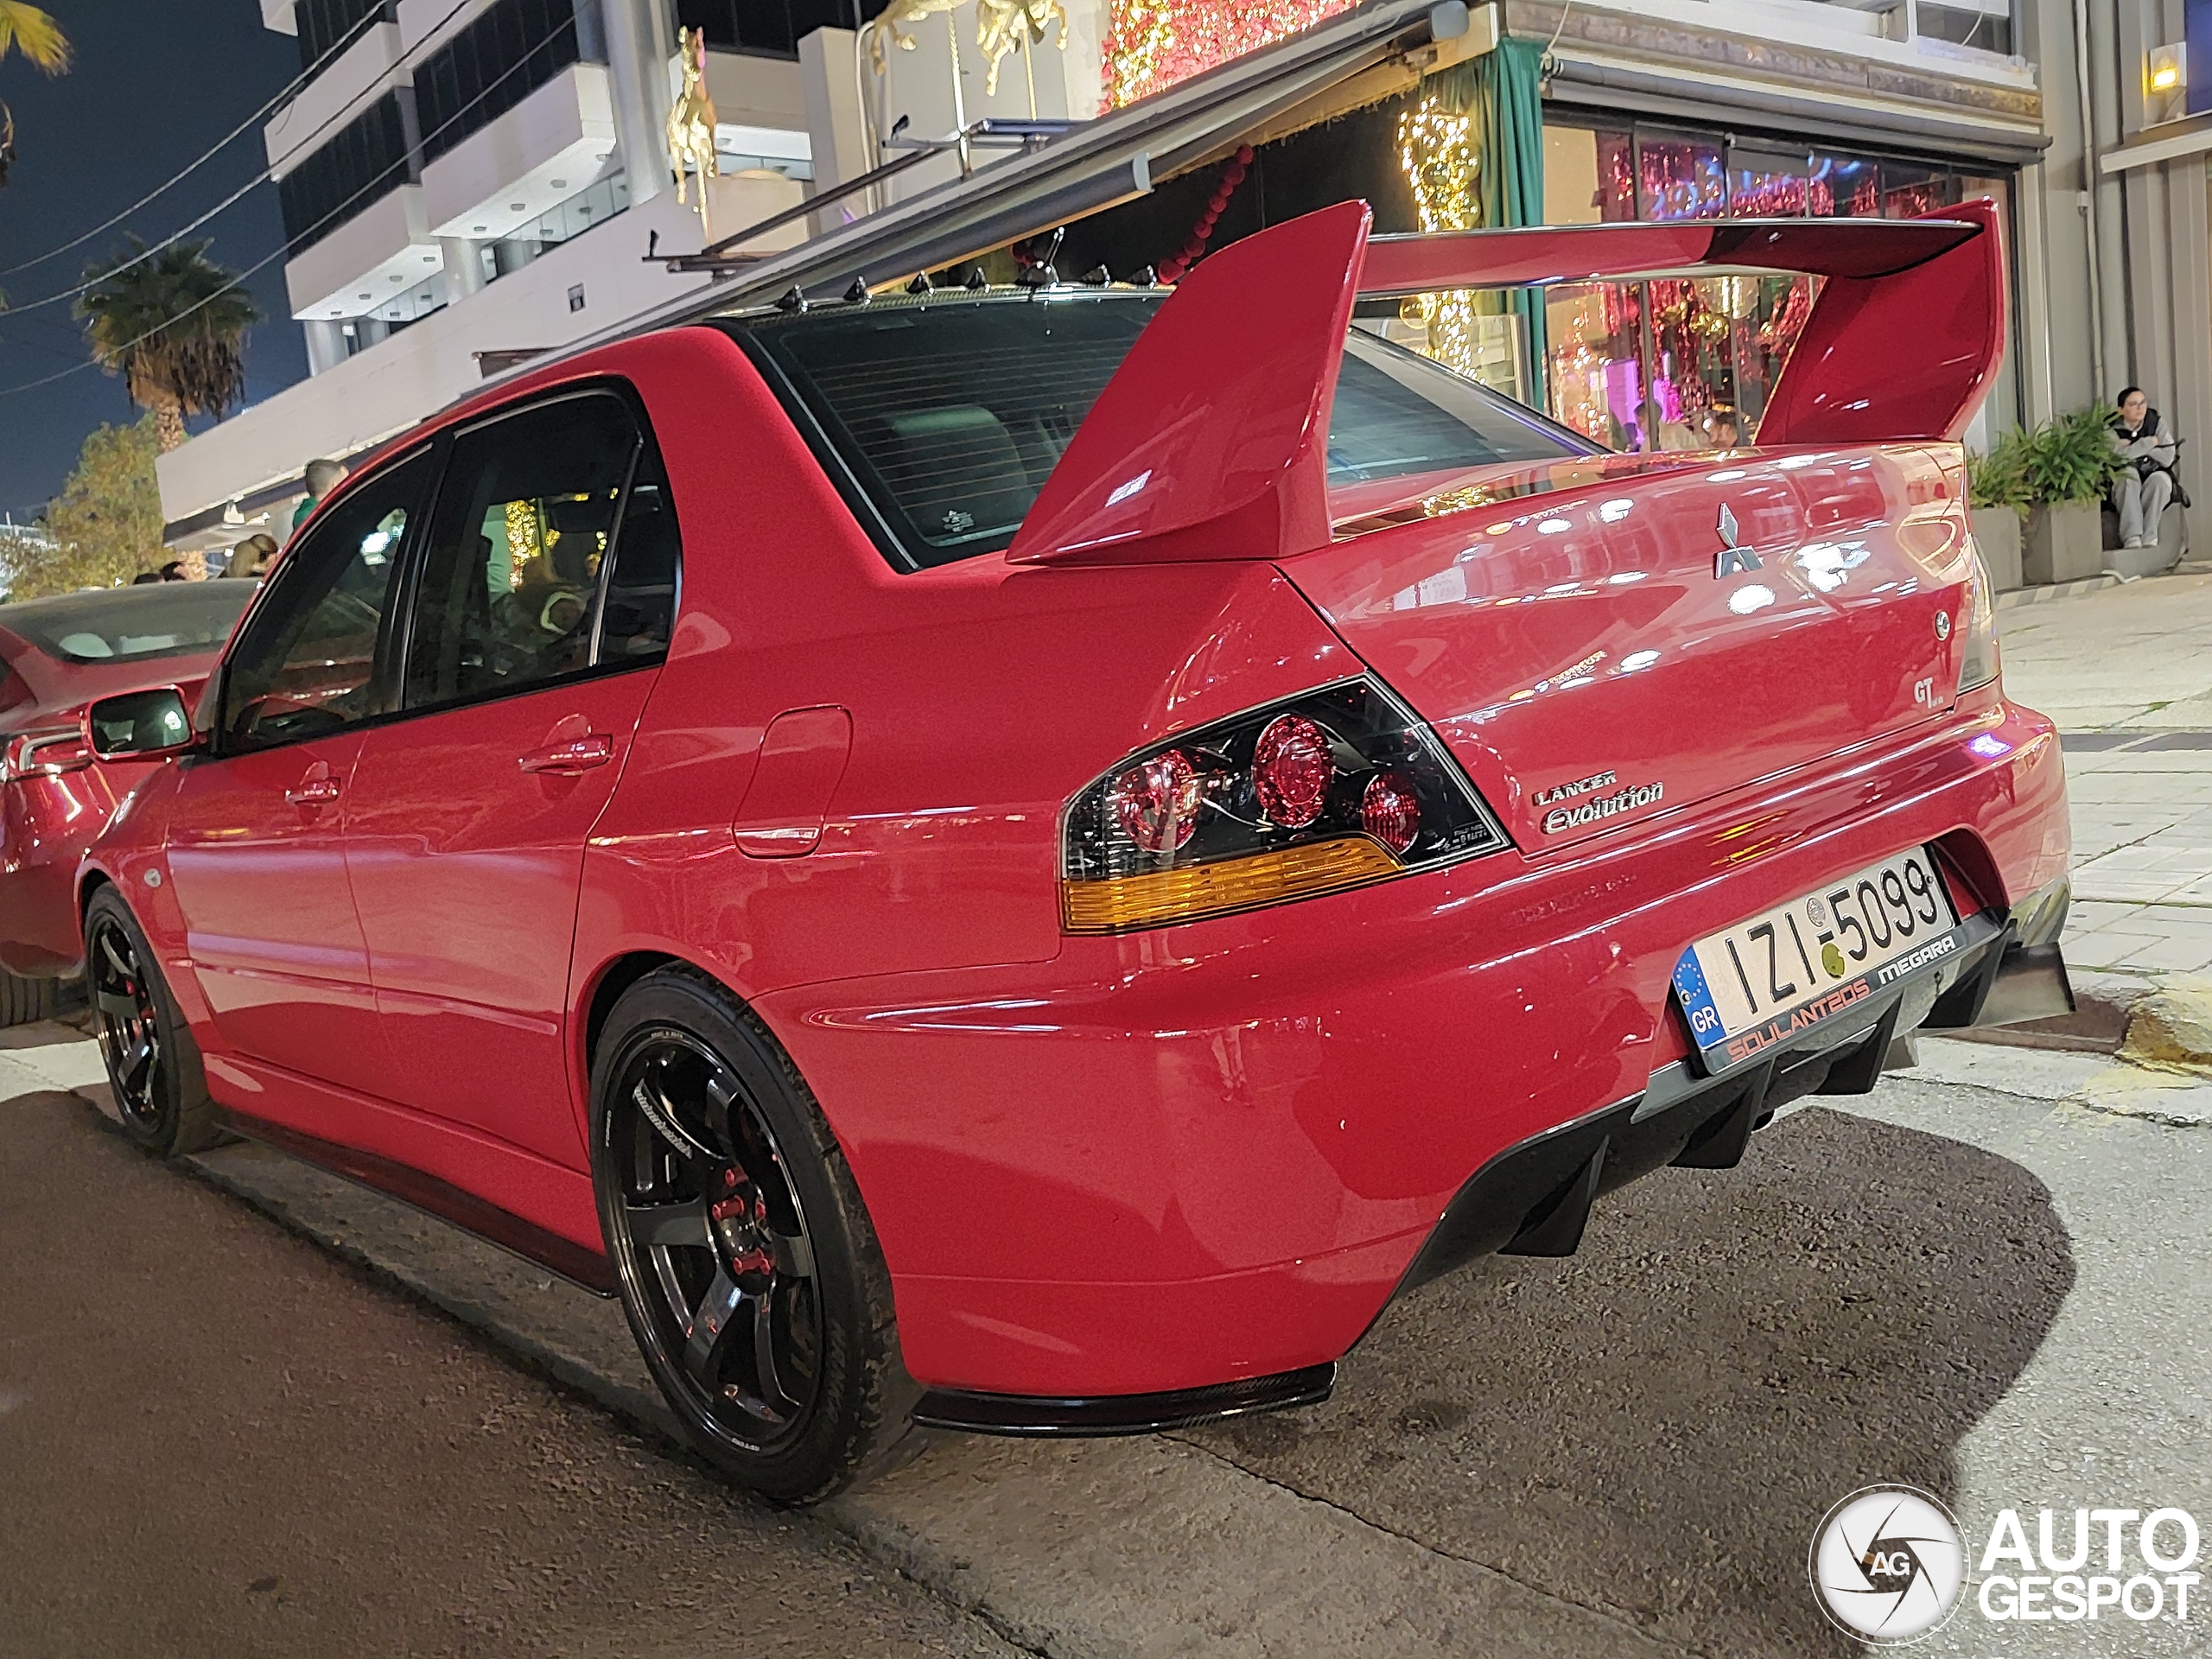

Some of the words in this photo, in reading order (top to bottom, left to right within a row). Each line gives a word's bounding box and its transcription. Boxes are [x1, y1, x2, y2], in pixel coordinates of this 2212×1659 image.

[1532, 769, 1618, 807] LANCER
[1541, 781, 1664, 835] Evolution
[1877, 934, 1956, 985] MEGARA
[1691, 1006, 1719, 1033] GR
